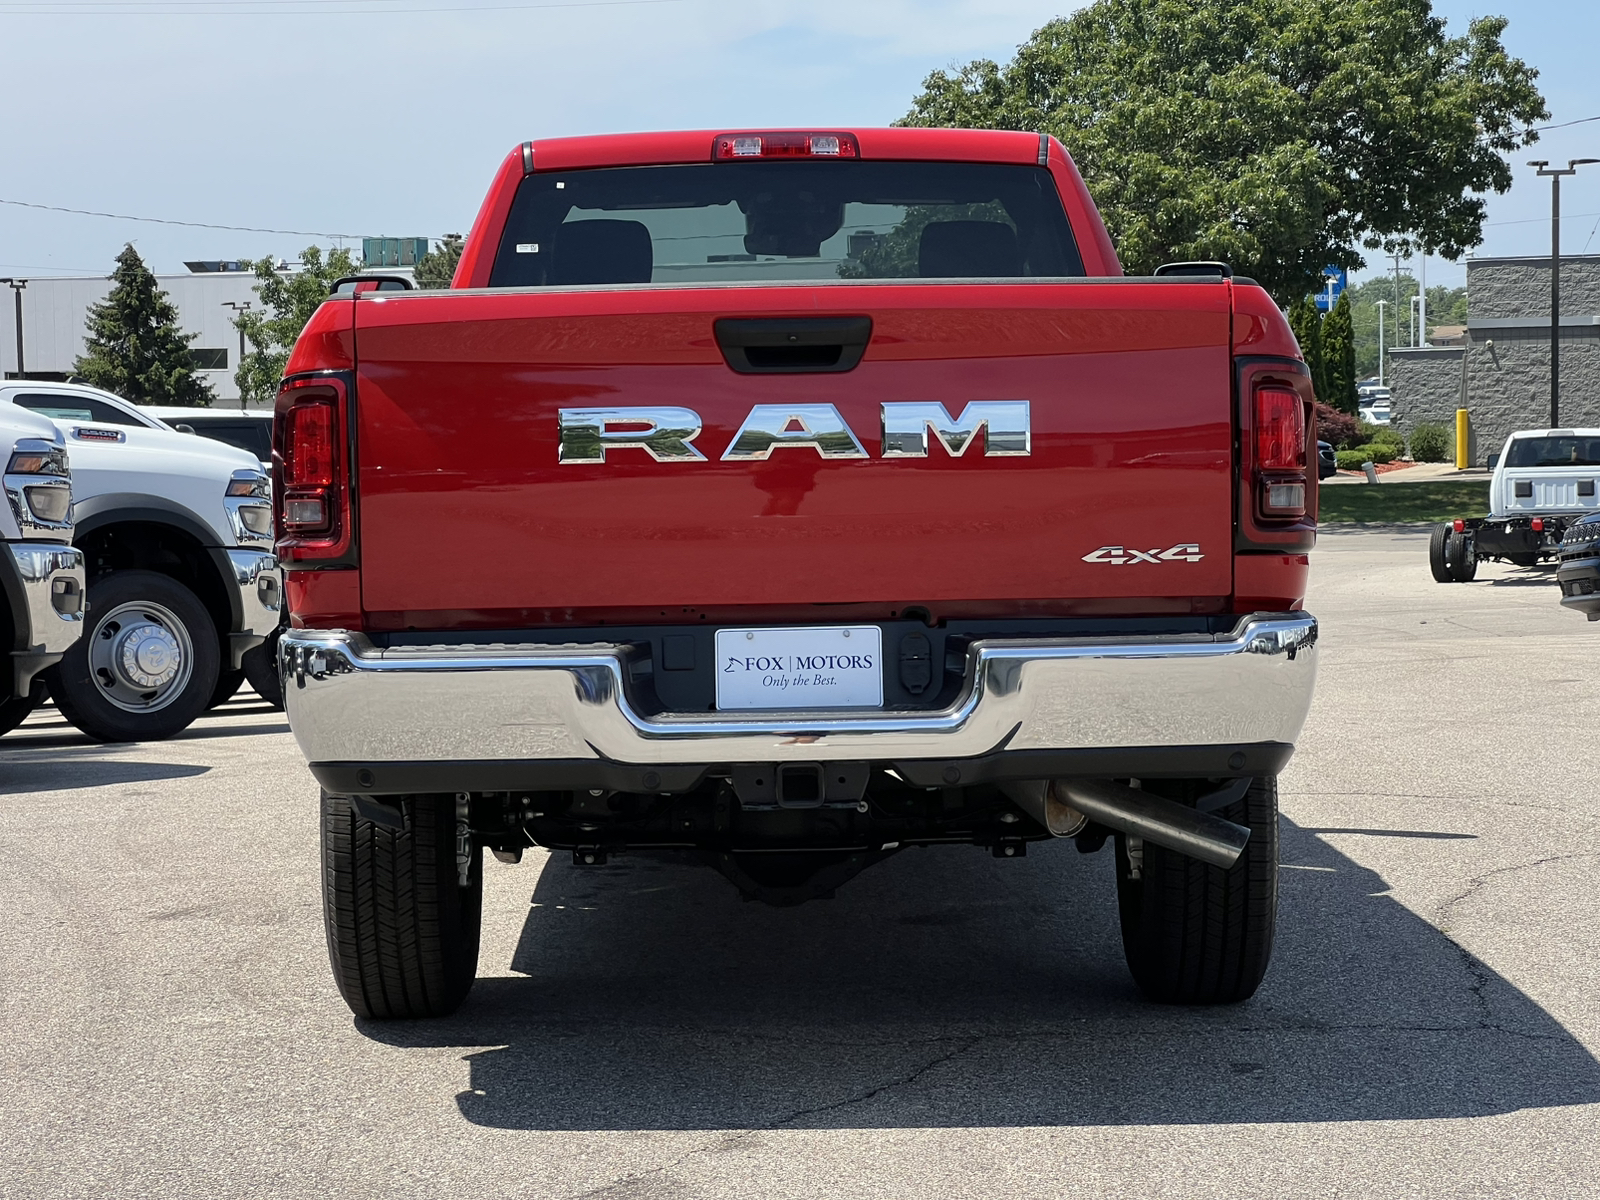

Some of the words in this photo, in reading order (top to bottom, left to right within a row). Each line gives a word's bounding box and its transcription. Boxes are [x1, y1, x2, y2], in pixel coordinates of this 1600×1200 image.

[558, 400, 1031, 464] RAM
[1081, 543, 1205, 565] 4x4
[744, 656, 784, 671] FOX
[796, 655, 873, 670] MOTORS
[762, 675, 790, 690] Only
[792, 674, 810, 687] the
[812, 674, 837, 686] Best.
